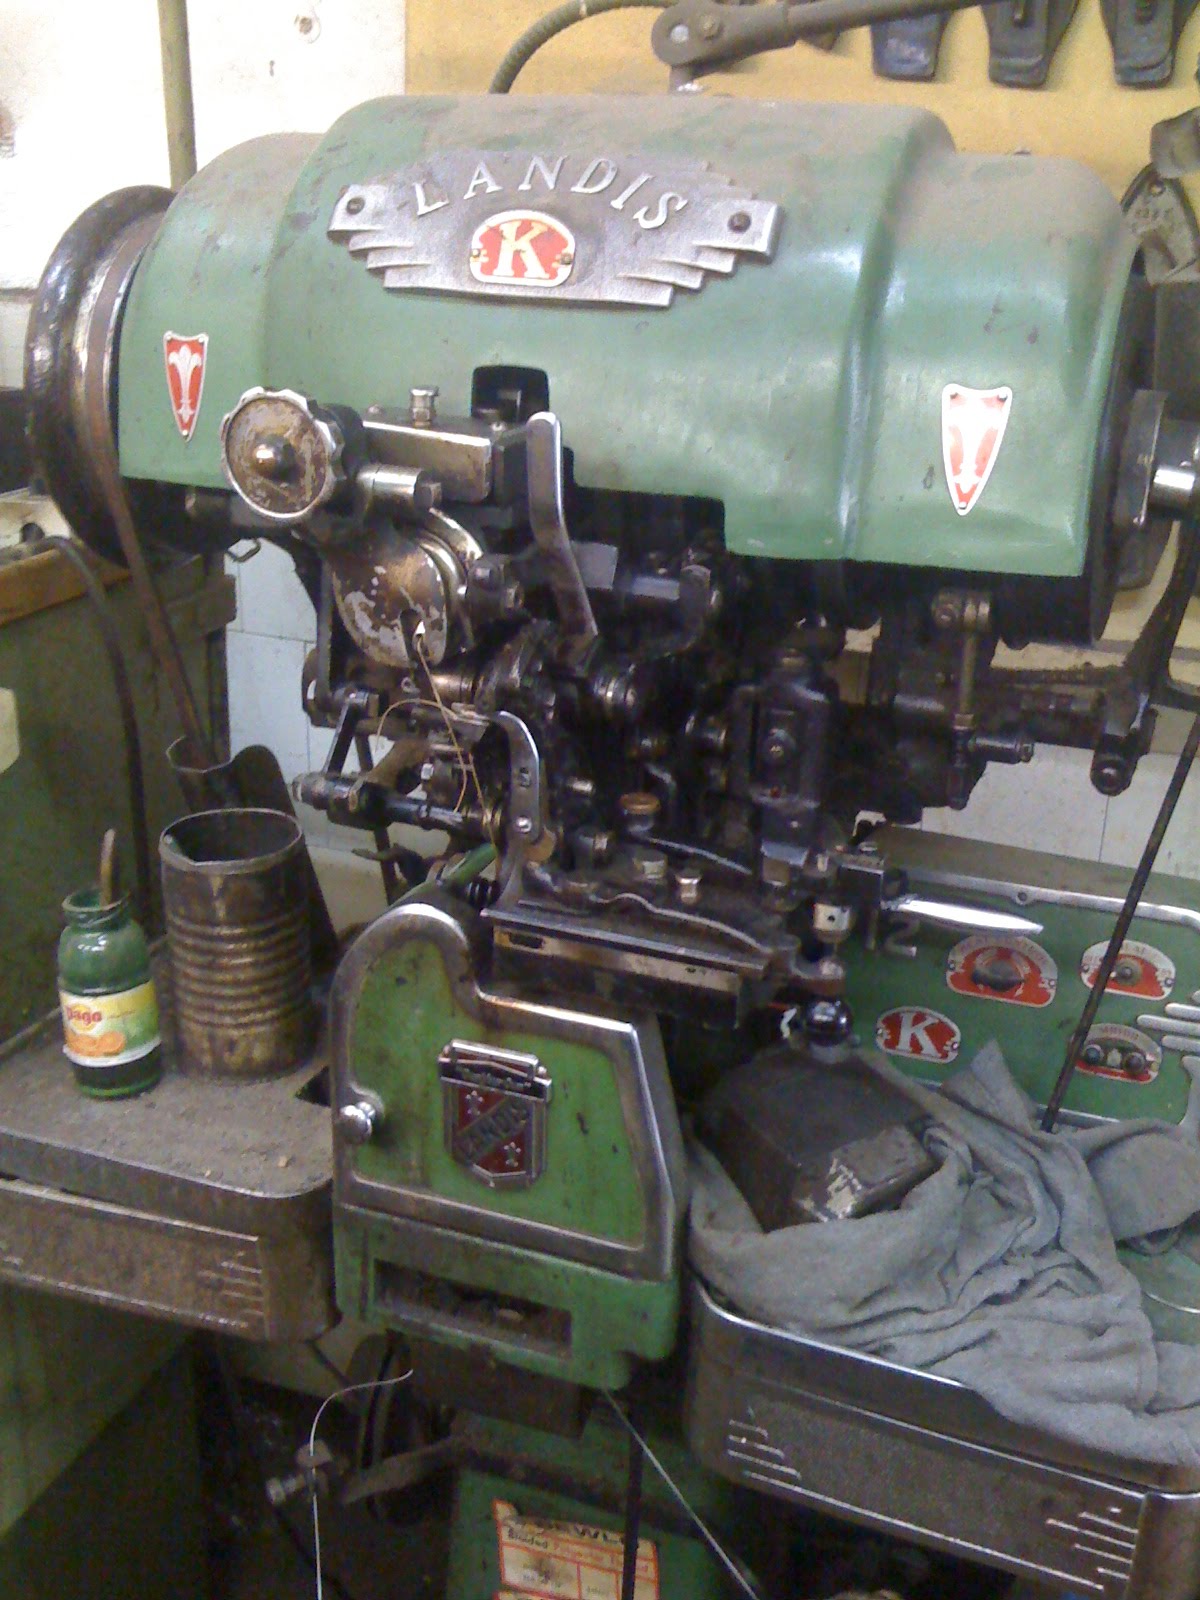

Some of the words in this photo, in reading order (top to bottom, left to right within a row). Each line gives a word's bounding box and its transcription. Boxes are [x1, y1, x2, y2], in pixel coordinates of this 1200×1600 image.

[411, 154, 688, 230] LANDIS
[494, 221, 550, 279] K
[898, 1011, 942, 1059] K
